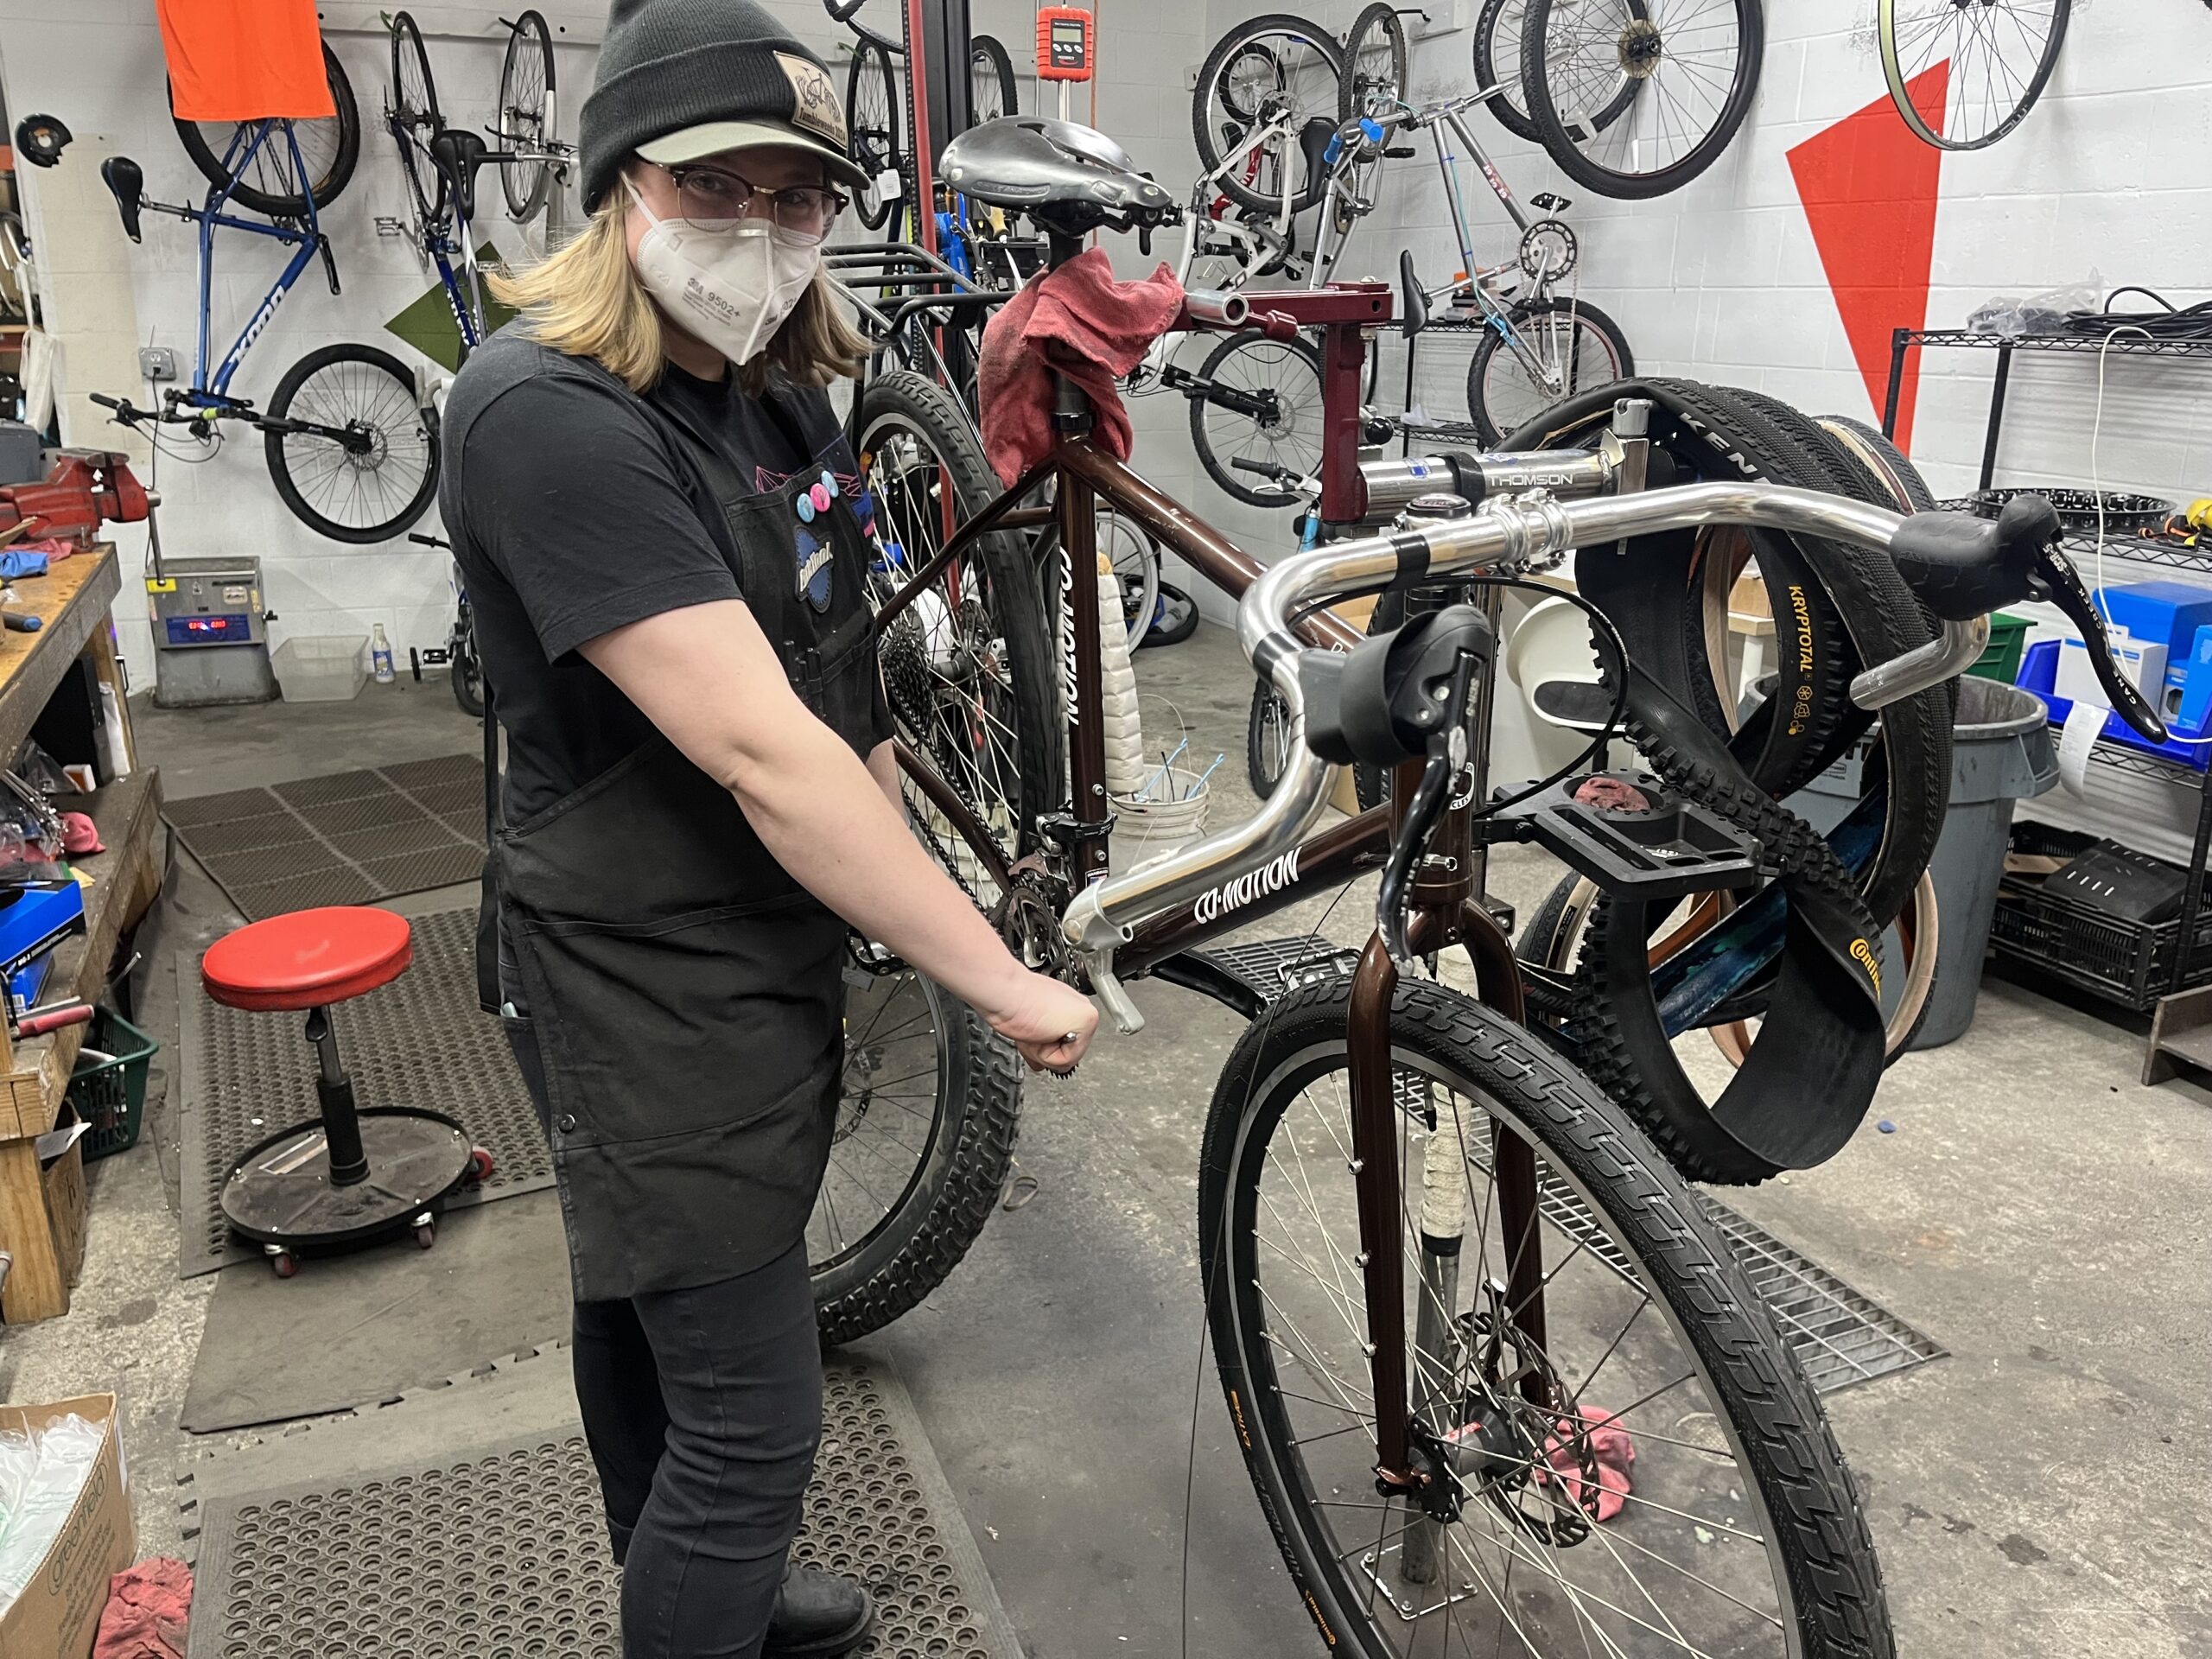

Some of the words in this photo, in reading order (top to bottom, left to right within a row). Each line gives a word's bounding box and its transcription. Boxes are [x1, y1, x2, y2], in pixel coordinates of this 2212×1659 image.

[708, 292, 741, 318] 9502+
[1490, 474, 1573, 486] THOMSON
[1789, 585, 1813, 672] KRYPTOTAL
[1307, 1596, 1337, 1645] Continental
